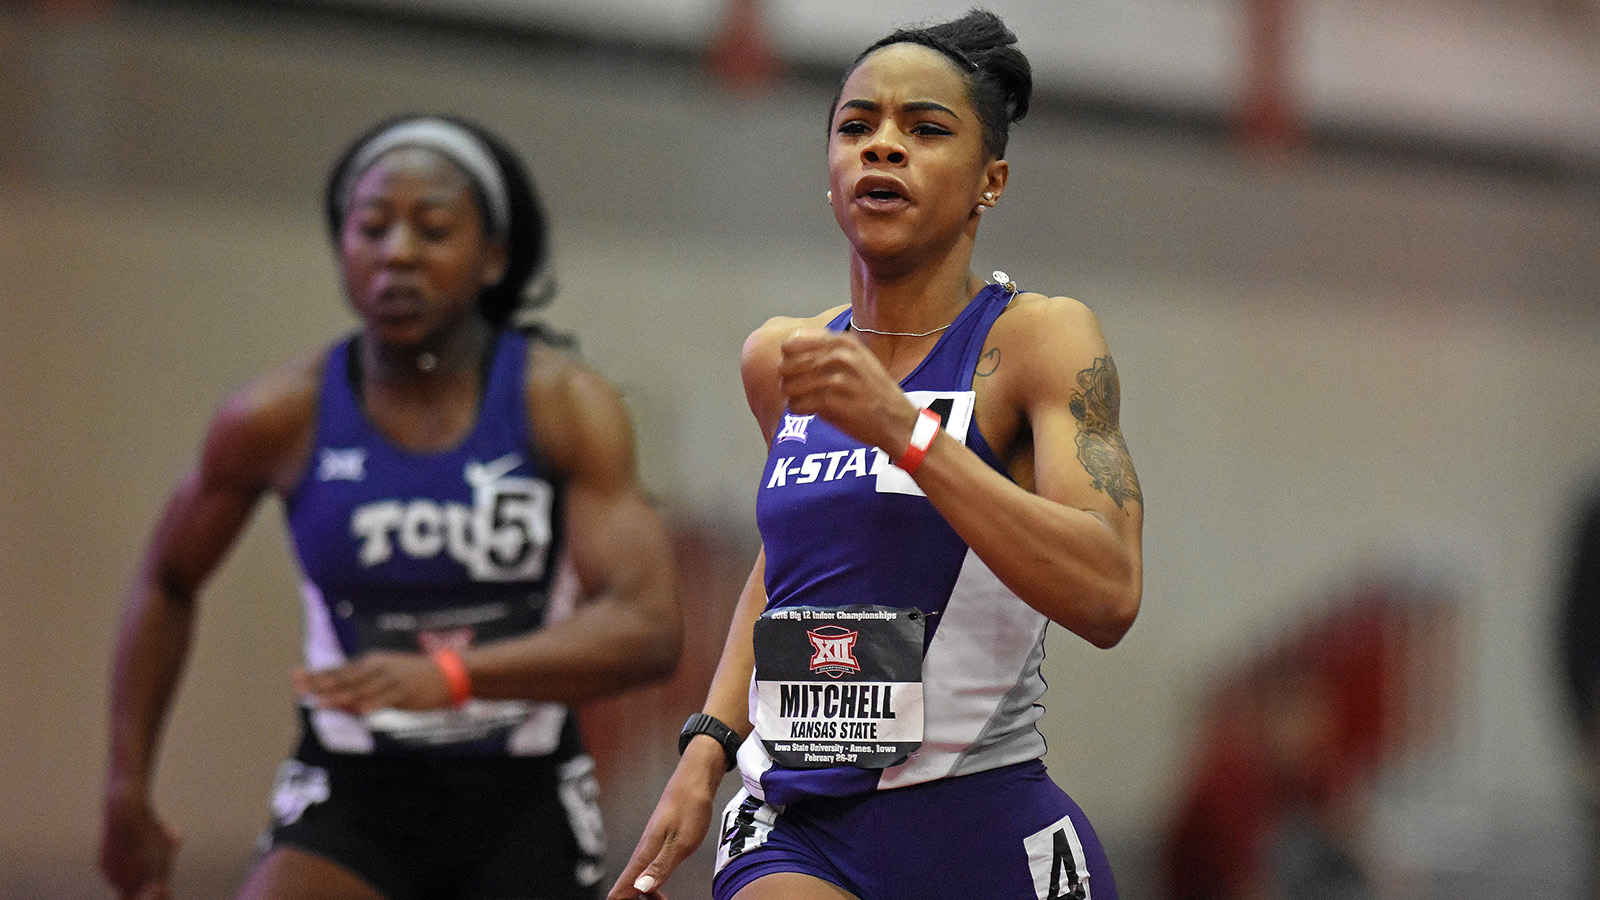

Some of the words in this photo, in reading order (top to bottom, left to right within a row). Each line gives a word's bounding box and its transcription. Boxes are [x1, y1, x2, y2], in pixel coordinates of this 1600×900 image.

[489, 491, 534, 570] 5
[789, 611, 802, 621] Big
[803, 611, 811, 619] 12
[812, 611, 835, 620] Indoor
[836, 611, 897, 621] Championships
[811, 635, 856, 666] XII
[779, 684, 896, 719] MITCHELL
[790, 721, 836, 739] KANSAS
[840, 722, 877, 739] STATE
[774, 743, 791, 752] Iowa
[792, 743, 809, 752] State
[809, 743, 844, 753] University
[850, 744, 874, 754] Ames,
[876, 744, 896, 753] Iowa
[804, 753, 834, 763] February
[835, 754, 858, 763] 26-27
